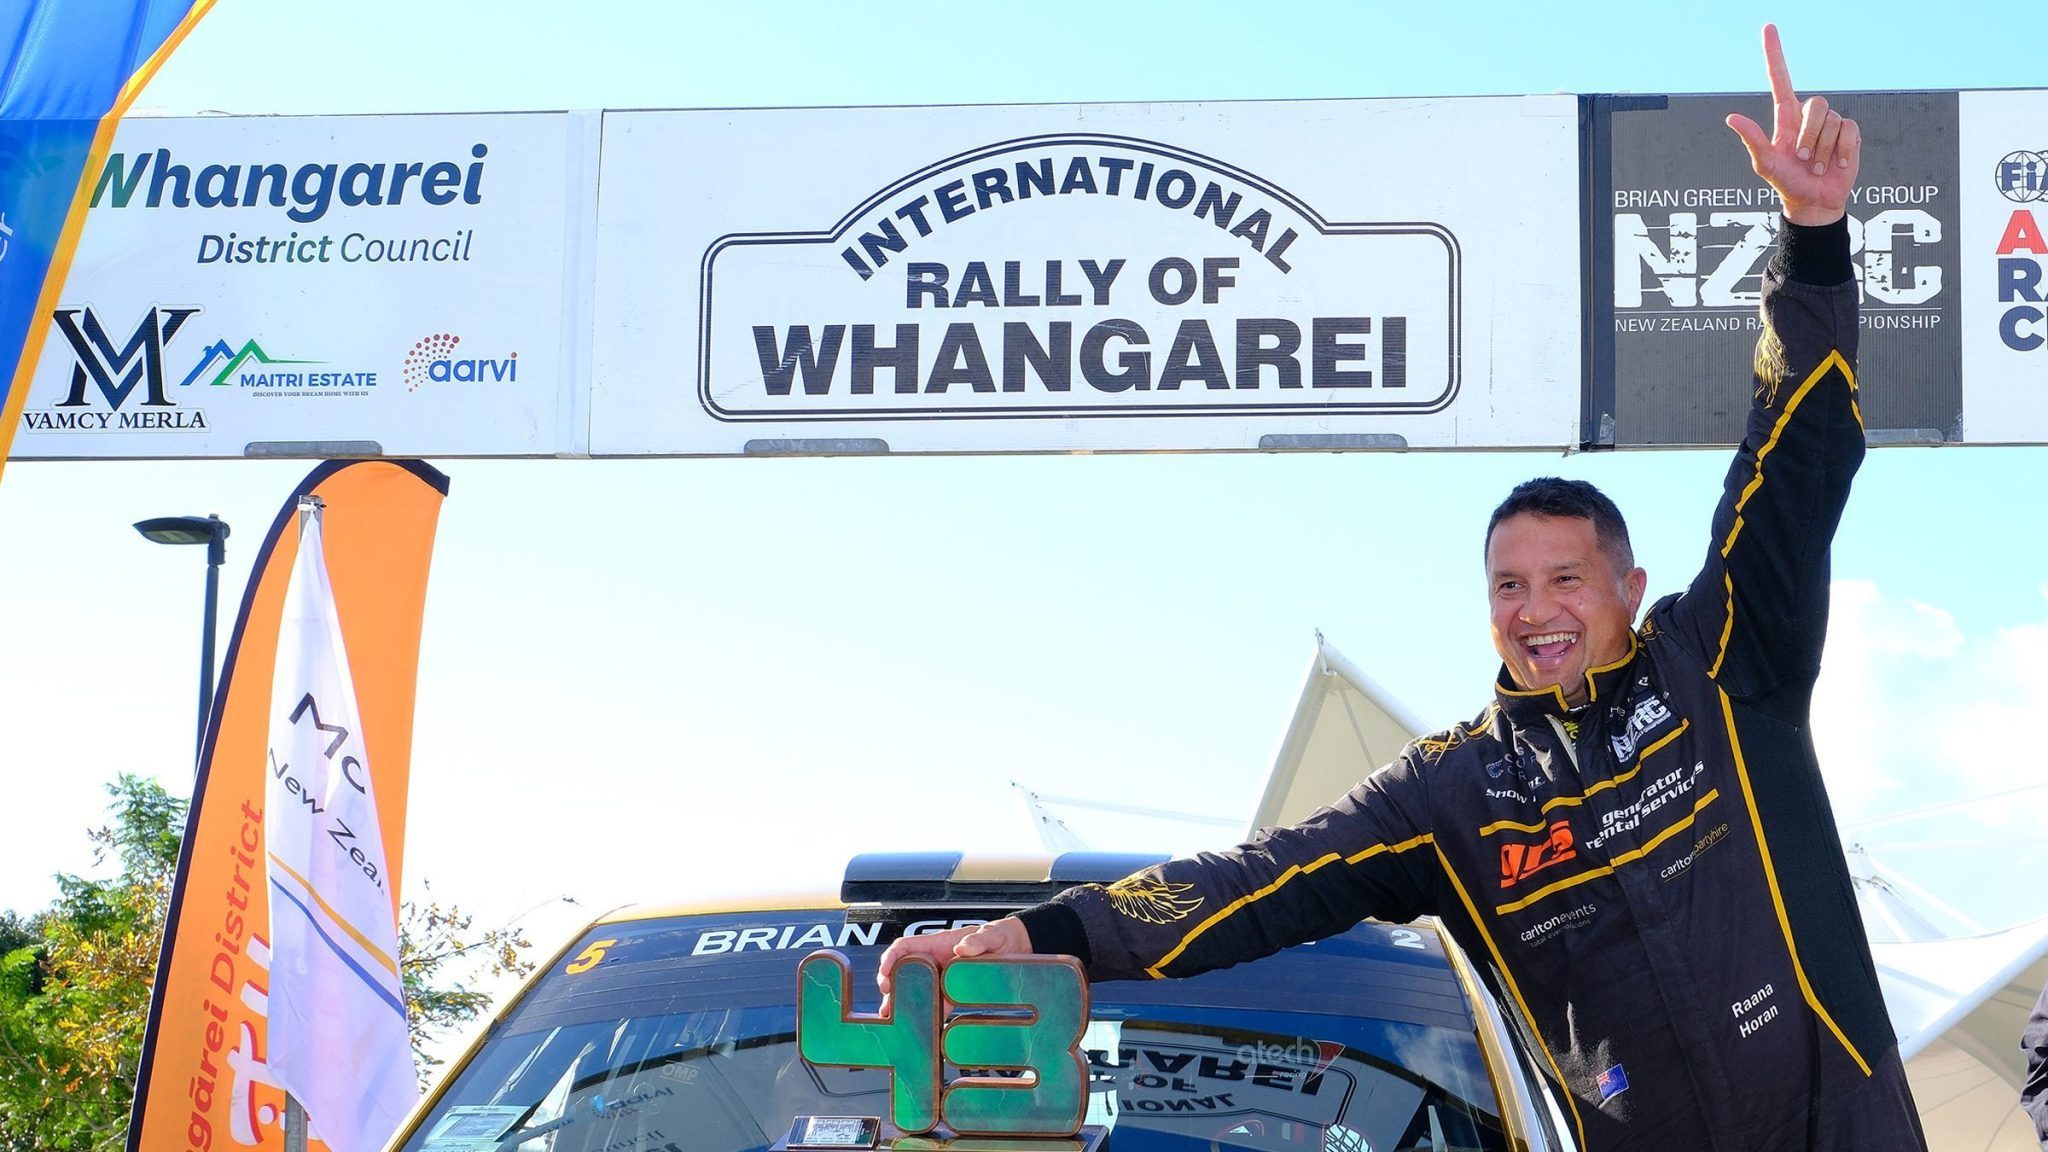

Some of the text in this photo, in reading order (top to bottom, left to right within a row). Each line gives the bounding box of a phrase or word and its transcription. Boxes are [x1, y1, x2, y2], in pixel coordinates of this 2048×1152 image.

[88, 142, 488, 223] Whangarei
[1615, 188, 1679, 208] BRIAN
[1679, 187, 1752, 207] GREEN
[1864, 185, 1939, 204] GROUP
[841, 156, 1301, 281] INTERNATIONAL
[197, 229, 473, 264] District Council
[1614, 208, 1943, 309] NZC
[906, 256, 1241, 309] RALLY OF
[1615, 318, 1657, 333] NEW
[1660, 317, 1741, 333] ZEALAND
[1858, 314, 1941, 330] PIONSHIP
[428, 351, 518, 383] aarvi
[752, 316, 1408, 397] WHANGAREI
[240, 372, 377, 388] MAITRI ESTATE
[23, 410, 207, 430] VAMCY MERLA
[269, 747, 325, 814] New
[209, 798, 264, 995] District
[565, 938, 617, 976] 5
[691, 921, 884, 958] BRIAN
[1391, 929, 1426, 950] 2
[1731, 983, 1774, 1019] Raana
[1738, 1004, 1779, 1039] Horan
